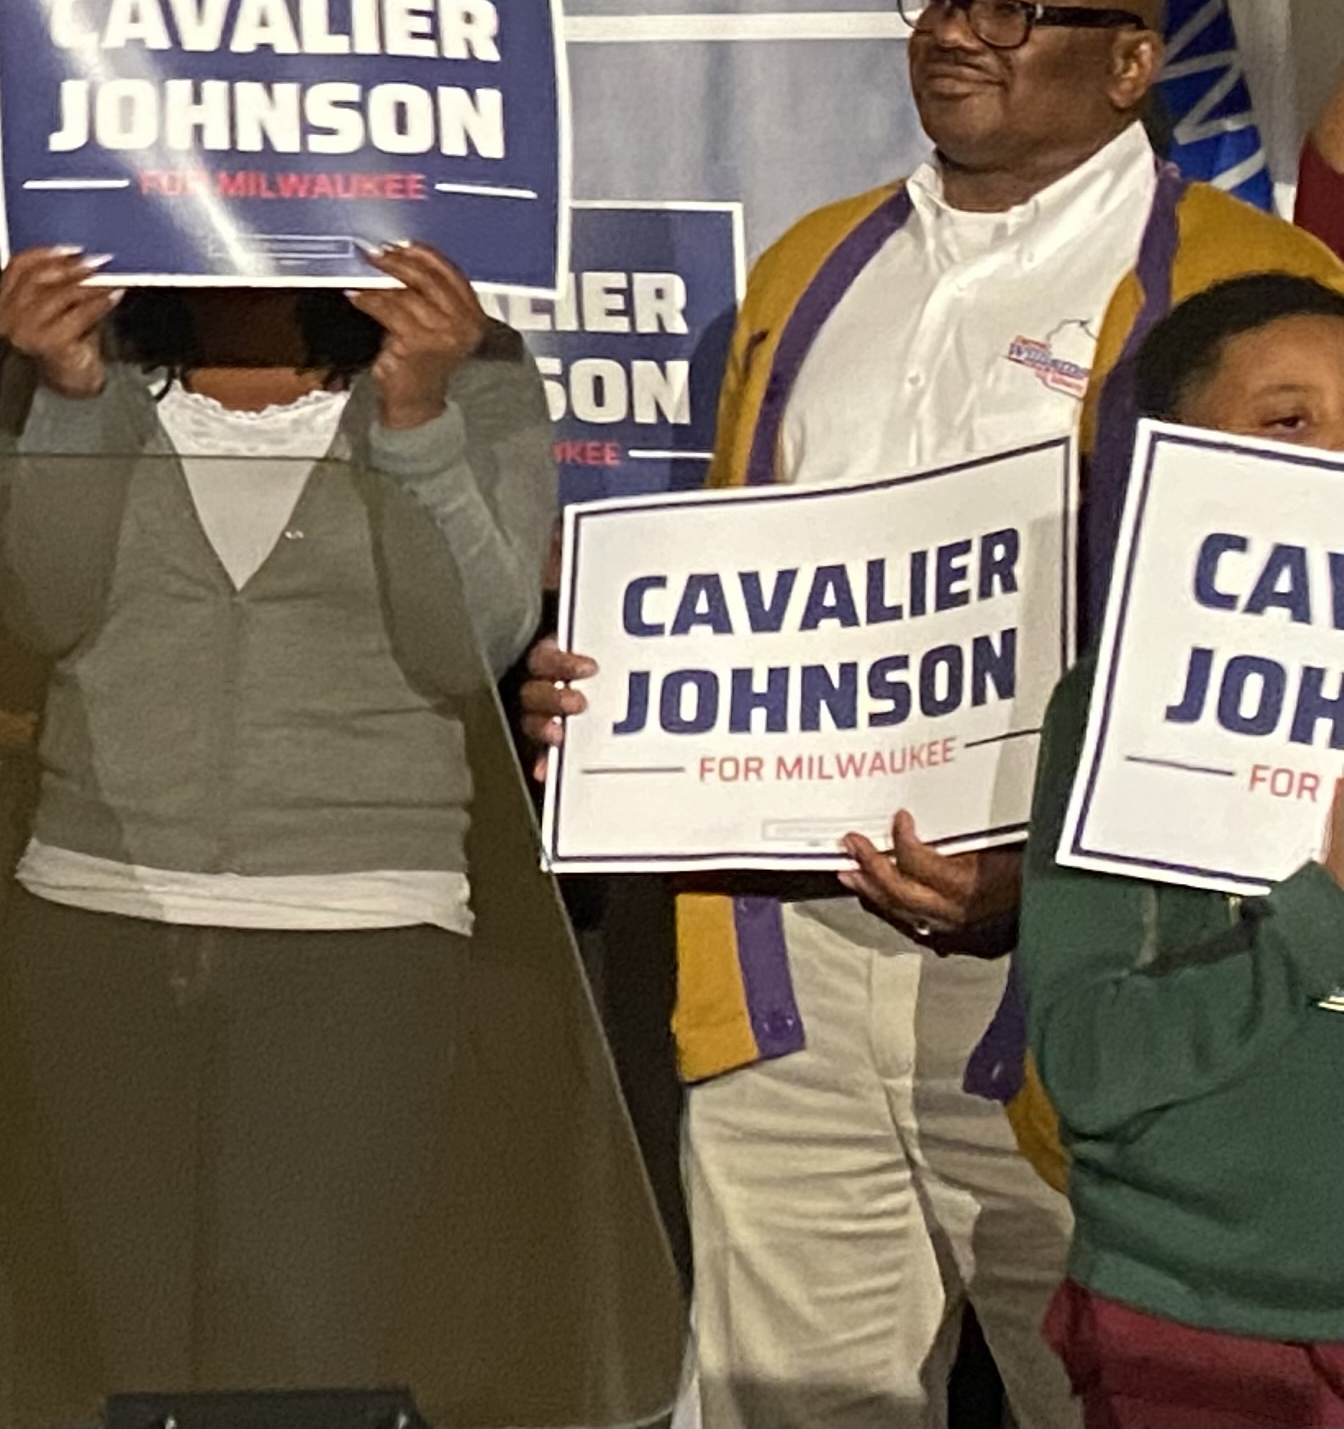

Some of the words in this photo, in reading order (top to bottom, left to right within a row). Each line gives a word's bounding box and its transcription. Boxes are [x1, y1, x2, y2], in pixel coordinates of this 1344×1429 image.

[48, 78, 504, 159] JOHNSON
[217, 171, 428, 200] MILWAUKEE
[478, 272, 689, 334] LIER
[622, 527, 1020, 637] CAVALIER
[612, 628, 1018, 735] JOHNSON
[699, 756, 763, 781] FOR
[775, 738, 957, 782] MILWAUKEE
[1249, 763, 1317, 802] FOR
